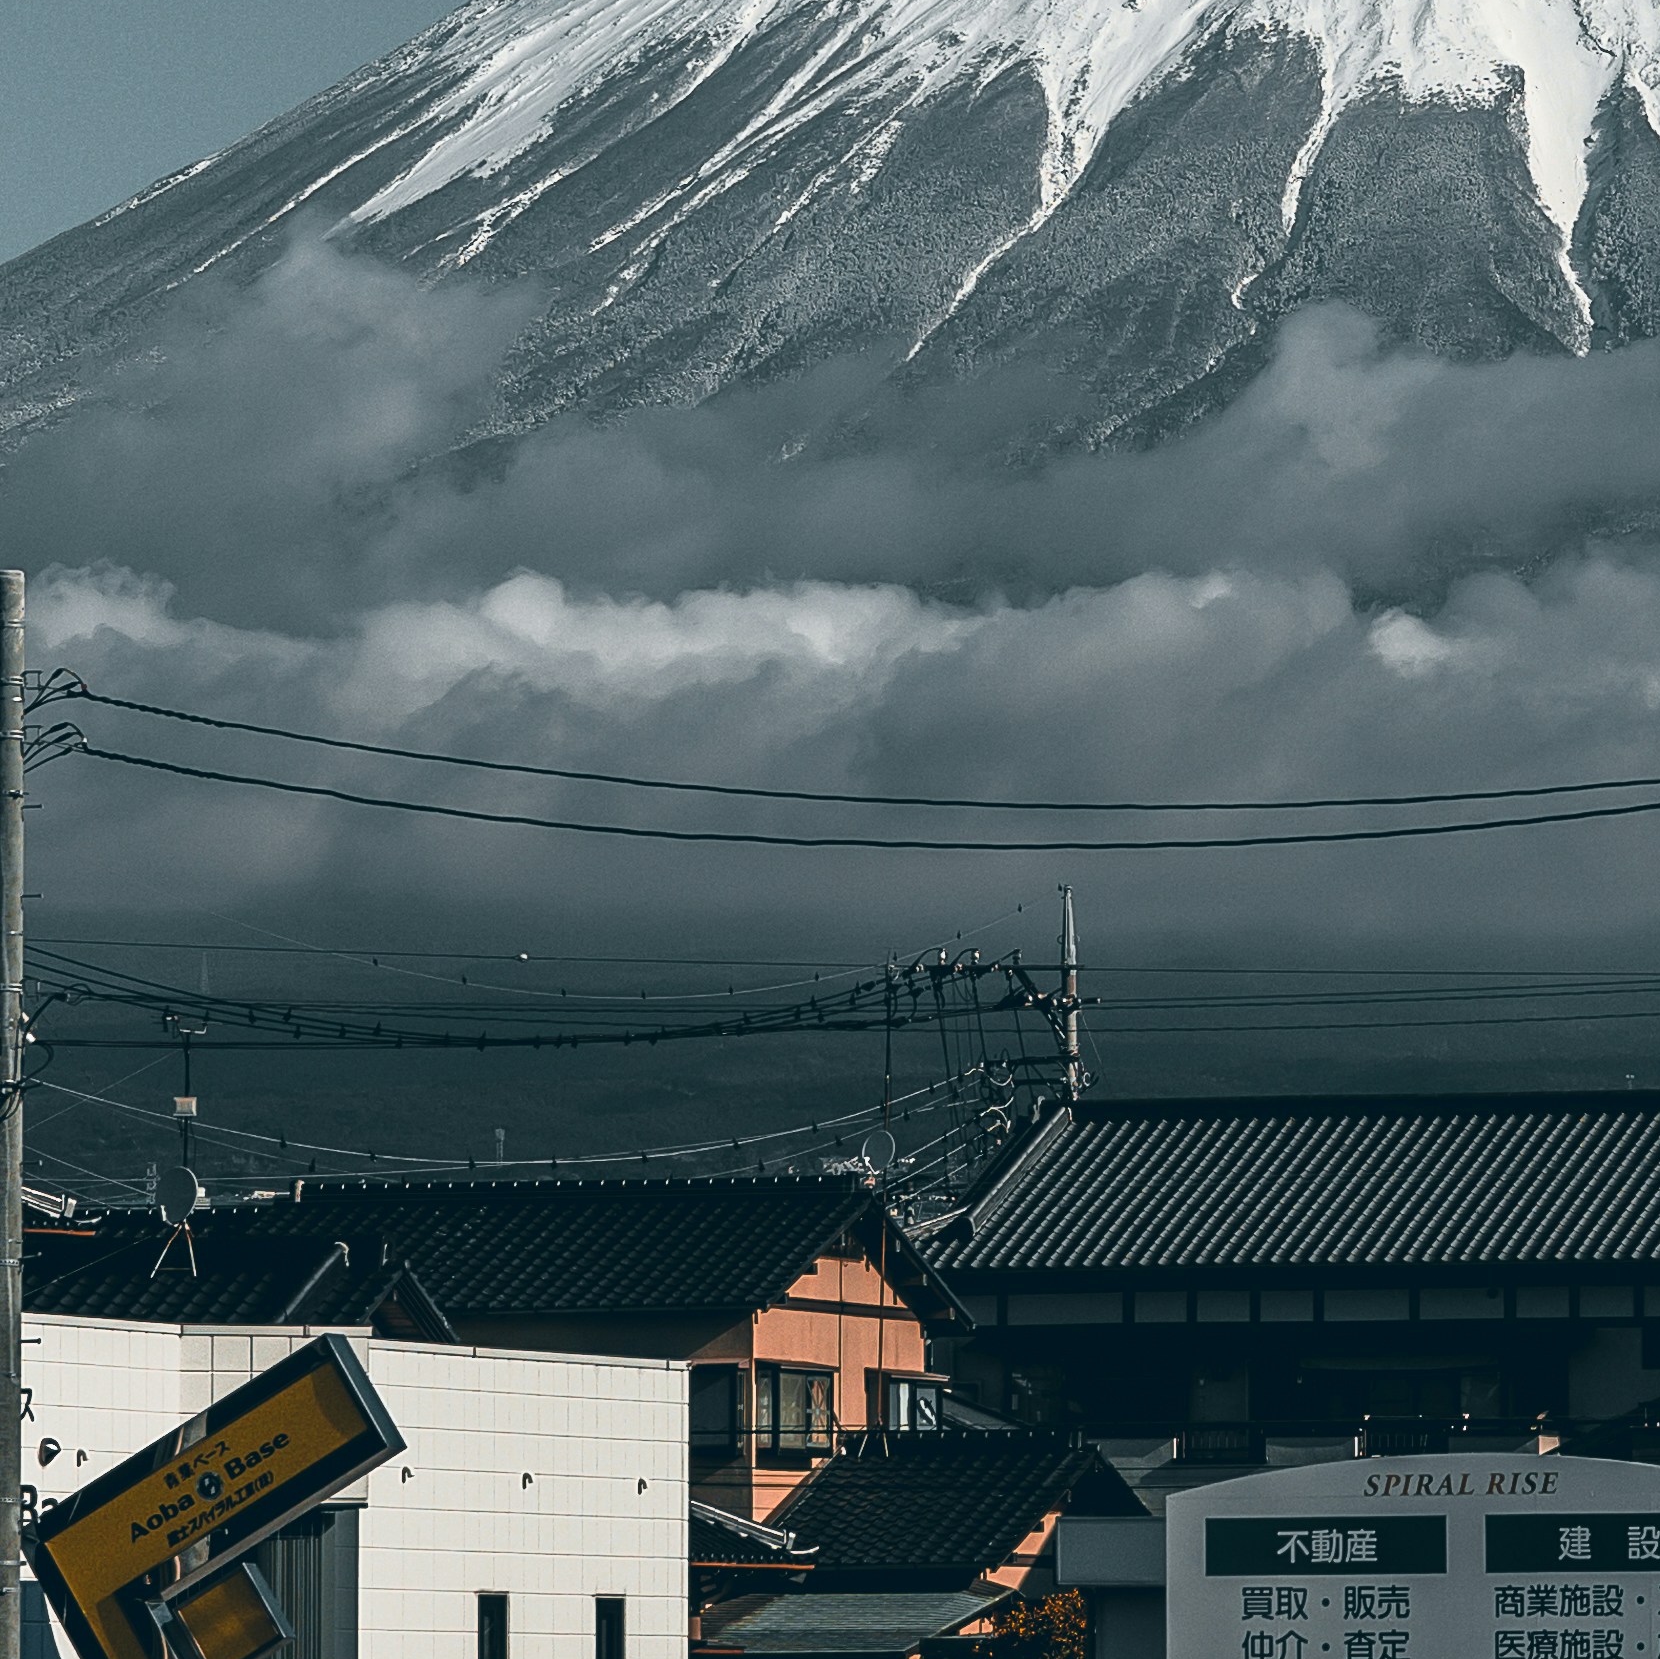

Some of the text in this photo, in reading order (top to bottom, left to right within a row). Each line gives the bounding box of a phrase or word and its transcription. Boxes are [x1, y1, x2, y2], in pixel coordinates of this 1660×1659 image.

[130, 1432, 290, 1544] Aoba Base
[1363, 1471, 1559, 1497] SPIRAL RISE
[1276, 1529, 1379, 1564] 不動産
[1241, 1585, 1411, 1621] 買取・販売
